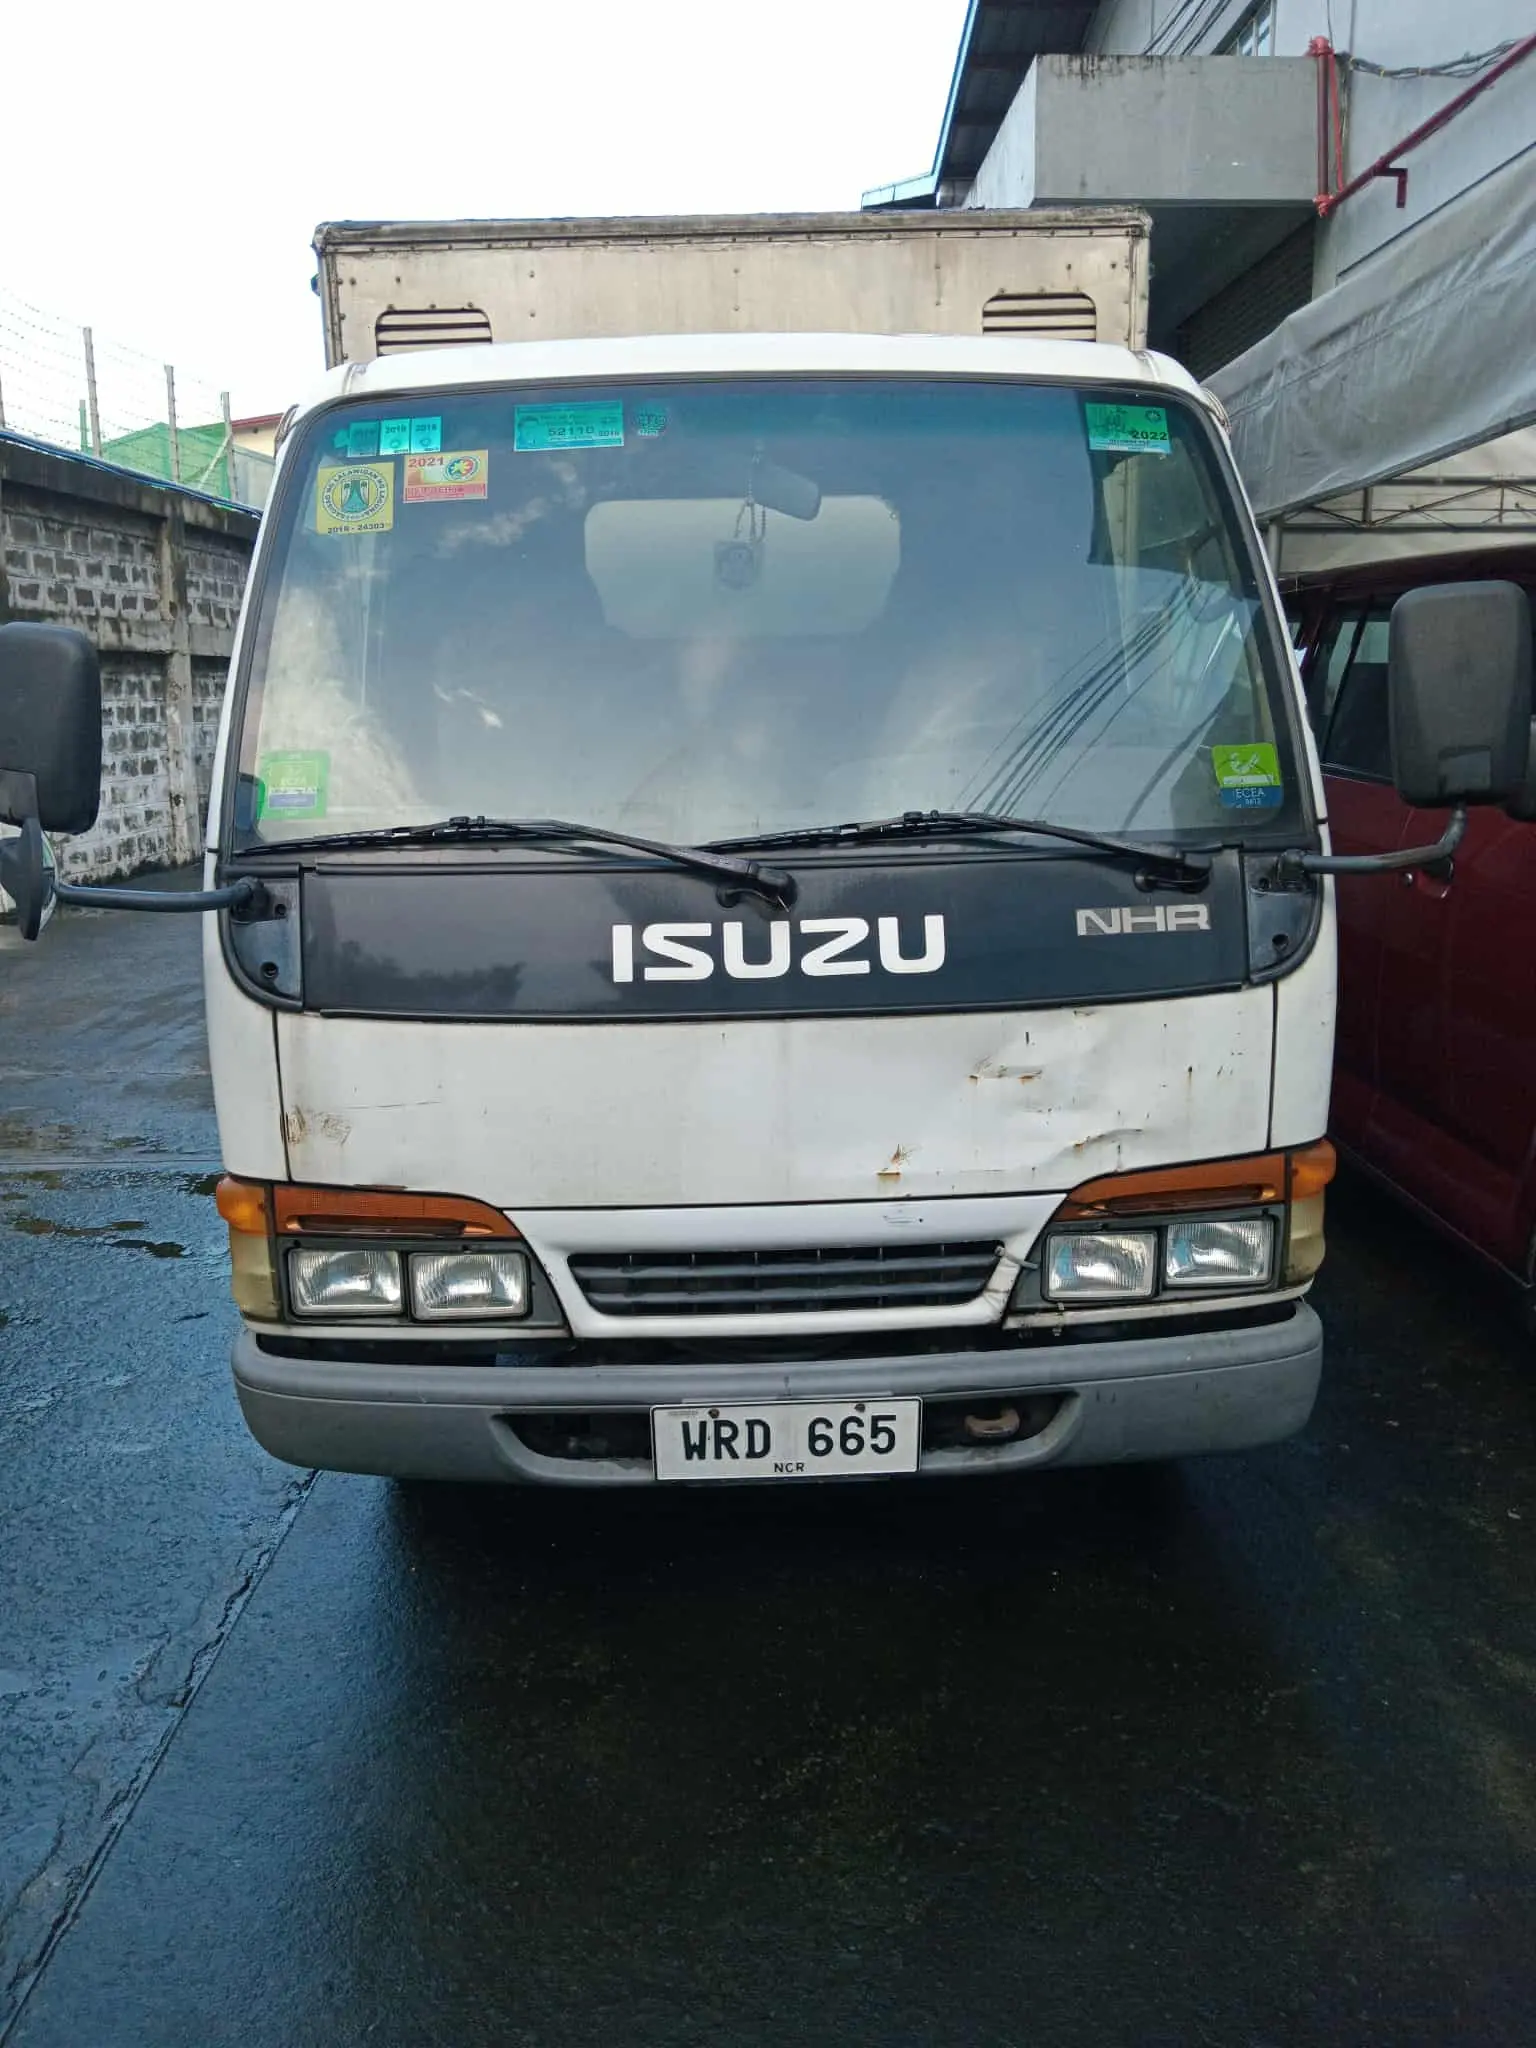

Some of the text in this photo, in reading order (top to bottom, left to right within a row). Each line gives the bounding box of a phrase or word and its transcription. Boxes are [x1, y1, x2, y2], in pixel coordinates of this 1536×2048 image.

[1131, 430, 1168, 440] 2022
[408, 456, 444, 468] 2021
[1076, 903, 1211, 937] NHR
[612, 914, 945, 983] ISUZU
[681, 1414, 897, 1461] WRD 665
[774, 1462, 805, 1473] NCR
